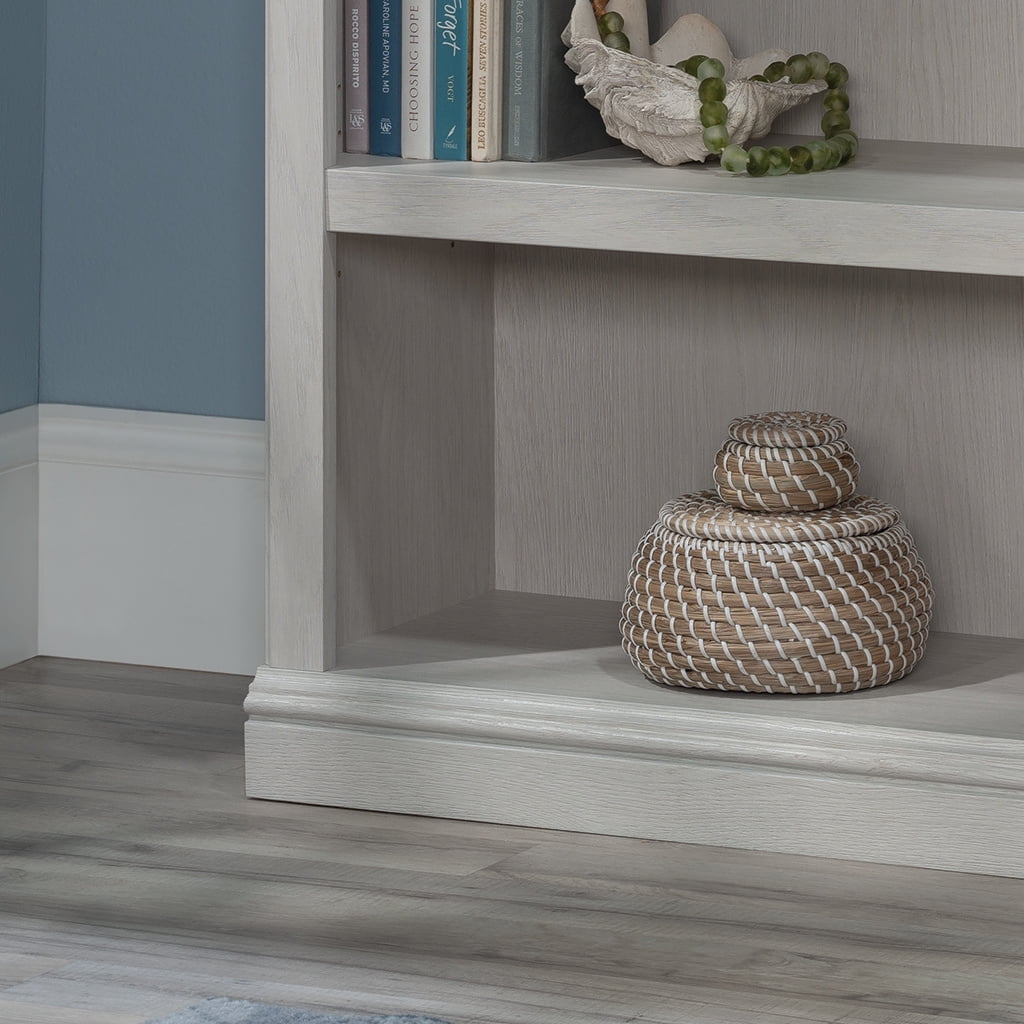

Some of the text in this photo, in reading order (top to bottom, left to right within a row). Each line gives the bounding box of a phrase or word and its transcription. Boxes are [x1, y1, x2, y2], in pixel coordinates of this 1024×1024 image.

[479, 1, 487, 39] STORIES
[351, 8, 360, 88] ROCCO DISPIRITO
[479, 41, 487, 72] SEVEN
[515, 37, 522, 48] OF
[383, 80, 390, 93] MD
[409, 5, 419, 132] CHOOSING HOPE
[514, 51, 523, 96] WISDOM
[477, 75, 486, 150] LEO BUSCAGLIA
